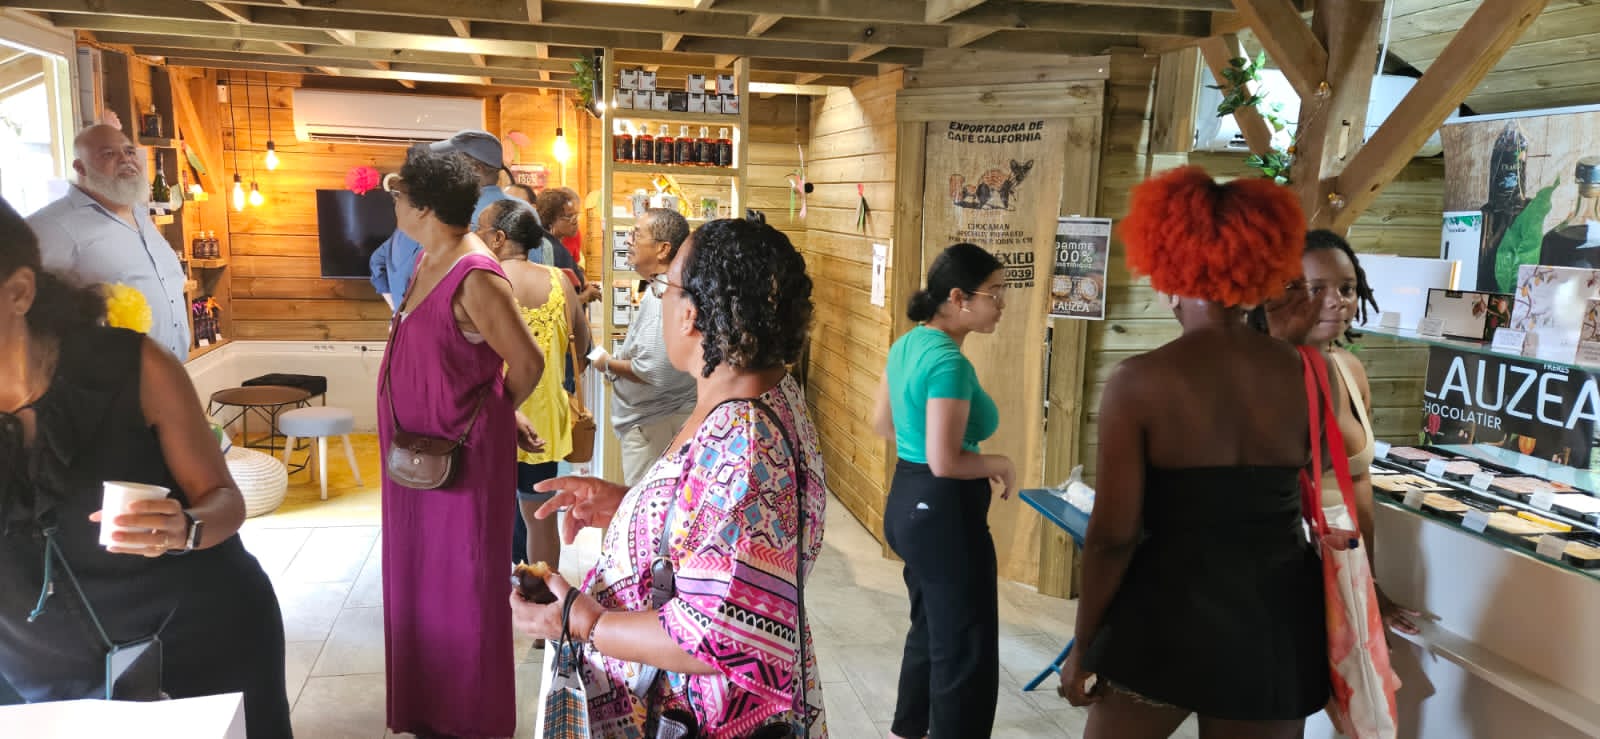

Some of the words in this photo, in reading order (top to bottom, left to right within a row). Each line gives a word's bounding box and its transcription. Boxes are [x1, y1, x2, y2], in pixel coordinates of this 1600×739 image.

[949, 121, 1025, 133] EXPORTADORA
[1029, 120, 1044, 130] DE
[977, 132, 1041, 144] CALIFORNIA
